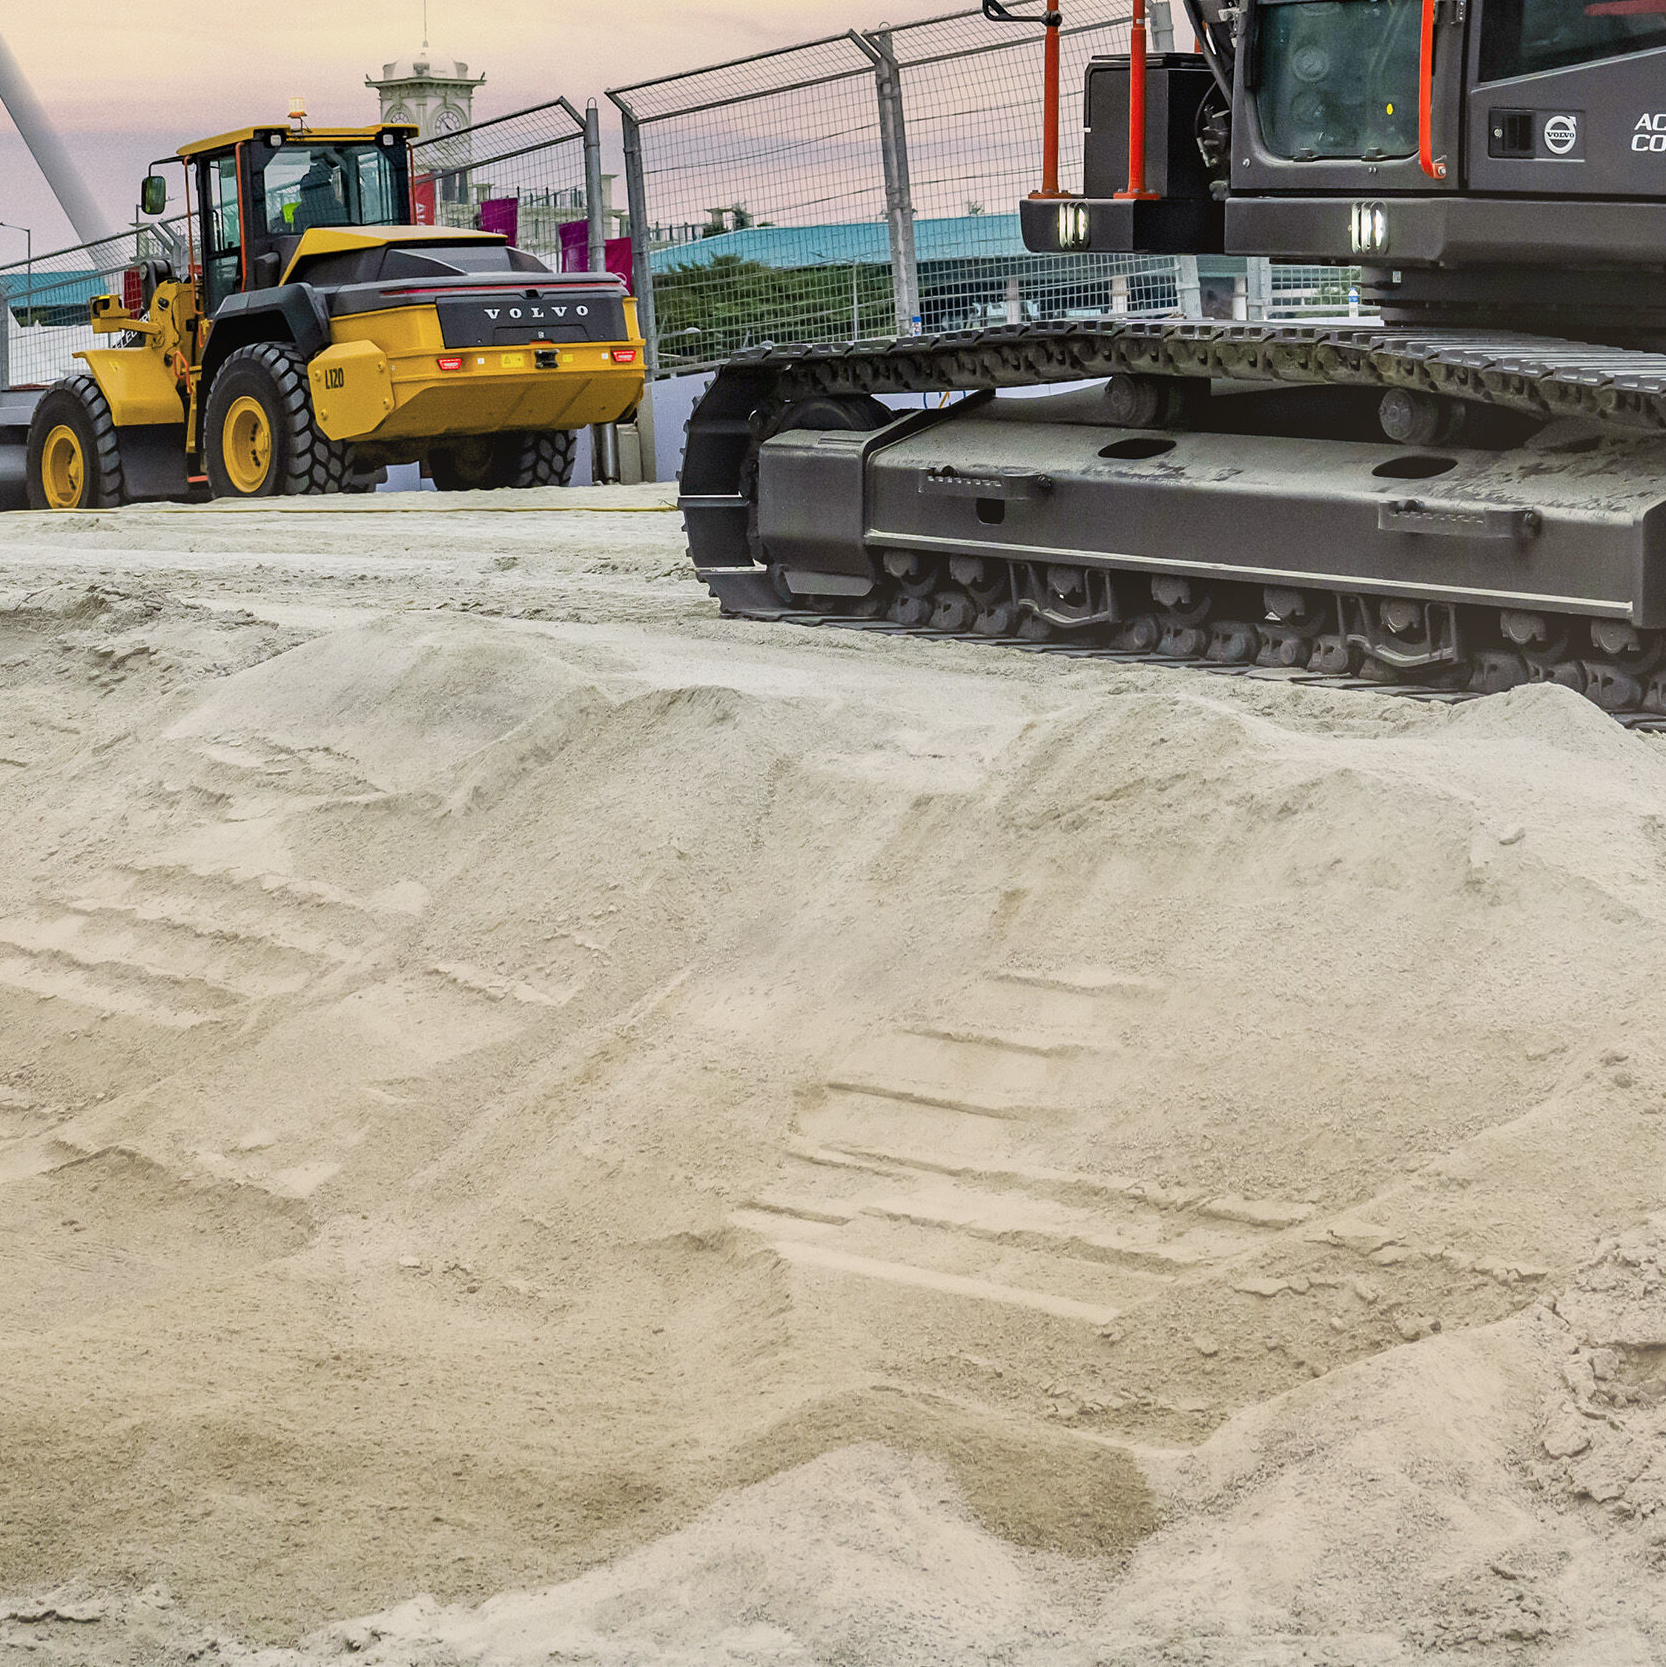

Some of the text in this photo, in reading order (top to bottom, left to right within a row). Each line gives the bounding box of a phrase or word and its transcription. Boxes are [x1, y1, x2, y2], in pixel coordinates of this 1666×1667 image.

[1546, 131, 1575, 139] VOLVO
[484, 305, 589, 319] VOLVO
[325, 367, 344, 390] L120
